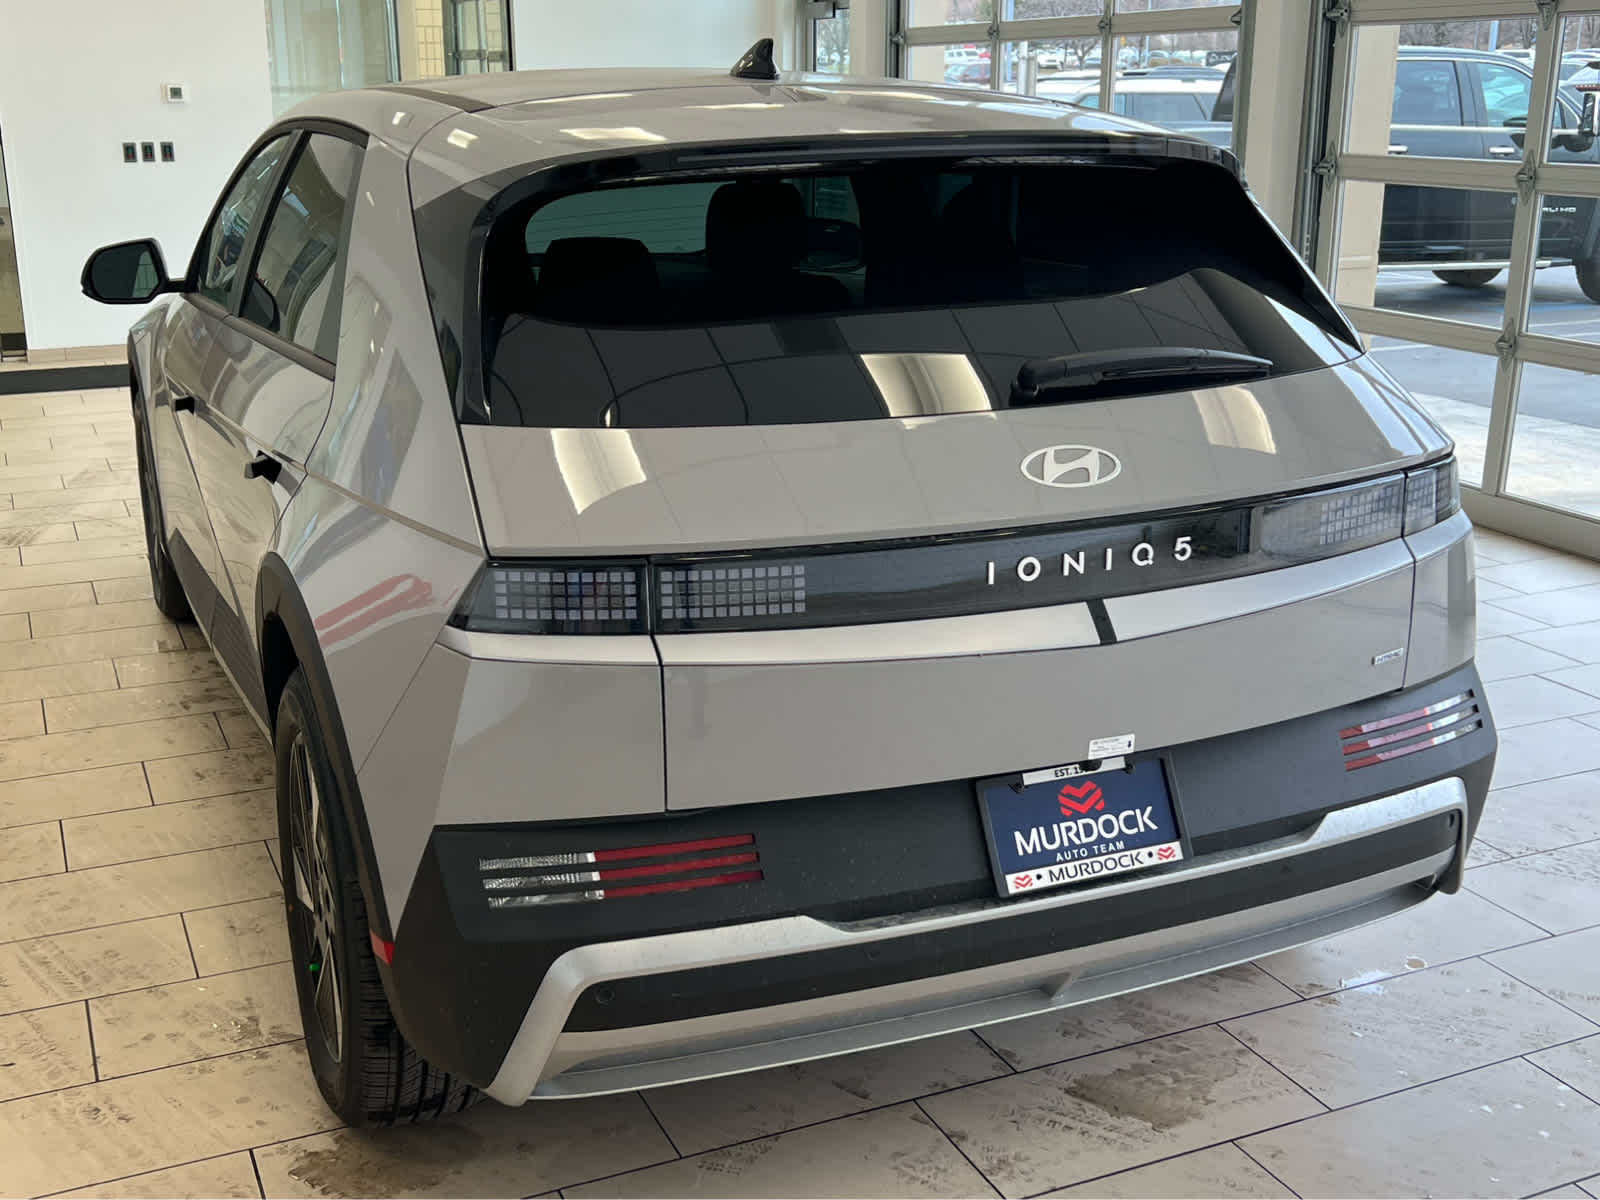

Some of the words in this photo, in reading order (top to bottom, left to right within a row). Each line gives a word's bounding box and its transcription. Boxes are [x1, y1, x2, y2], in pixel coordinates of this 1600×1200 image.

[987, 542, 1155, 585] IONIQ
[1174, 536, 1192, 561] 5
[1054, 767, 1074, 778] EST.
[1014, 806, 1158, 856] MURDOCK
[1048, 851, 1144, 883] MURDOCK
[1056, 847, 1088, 862] AUTO
[1093, 840, 1125, 854] TEAM
